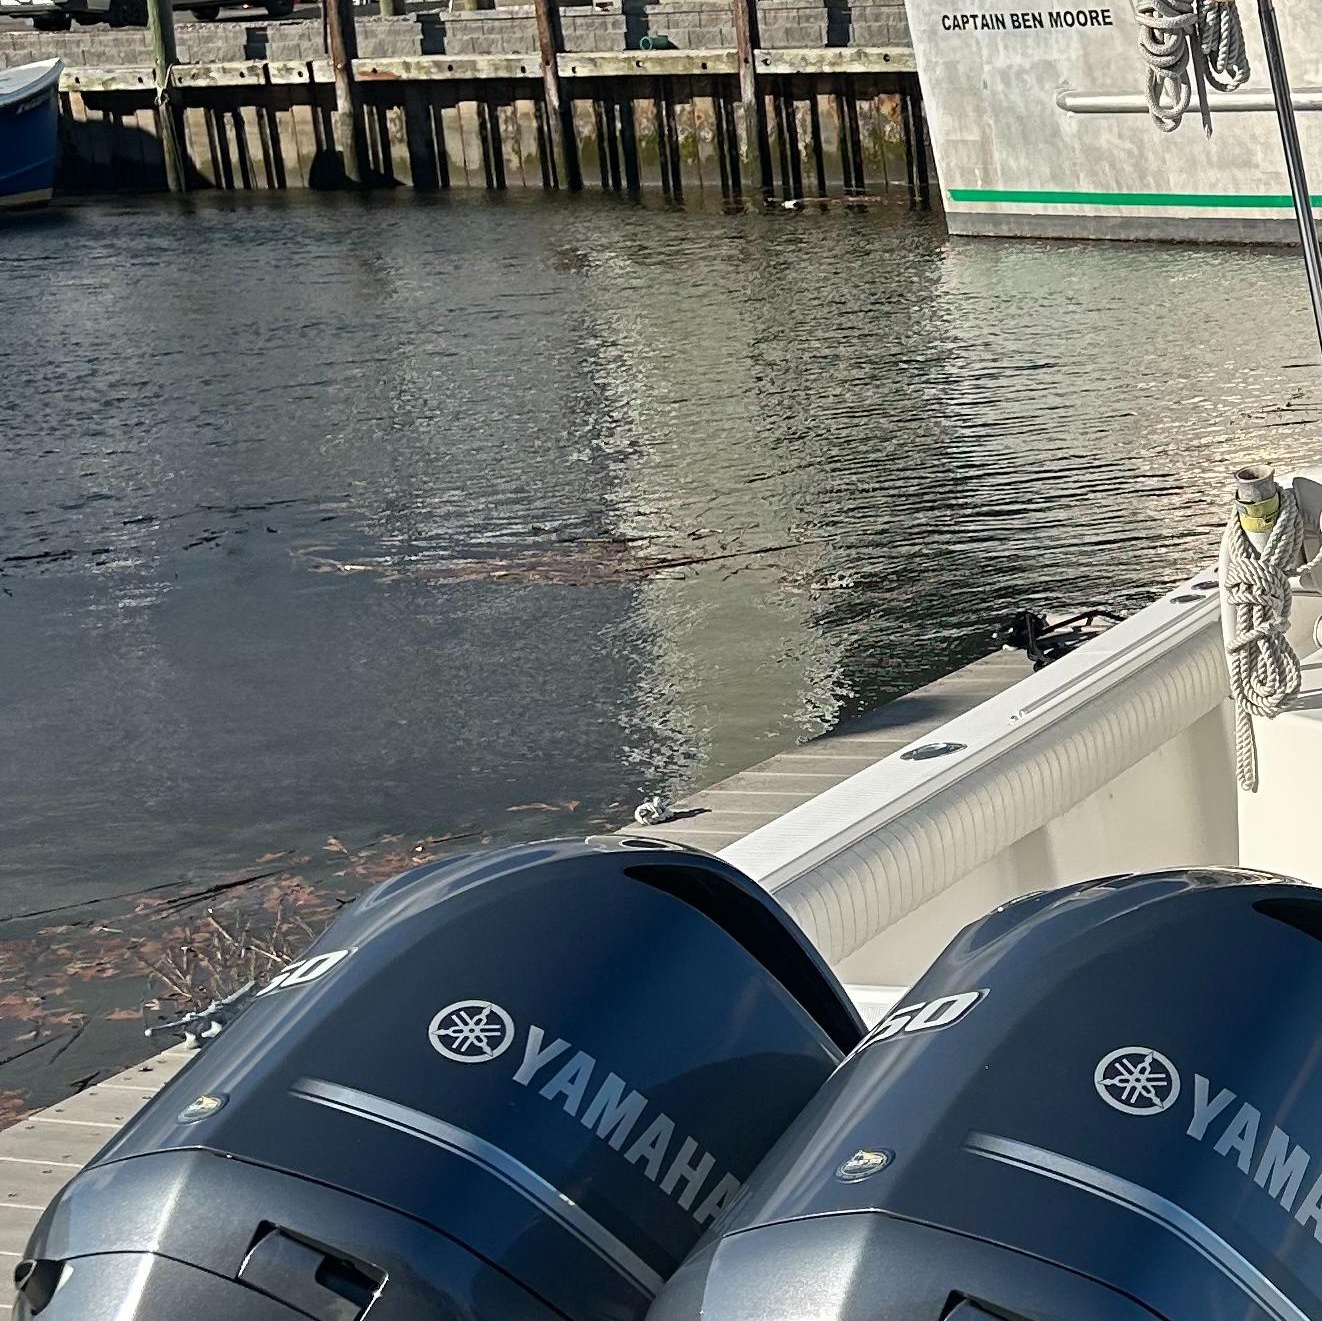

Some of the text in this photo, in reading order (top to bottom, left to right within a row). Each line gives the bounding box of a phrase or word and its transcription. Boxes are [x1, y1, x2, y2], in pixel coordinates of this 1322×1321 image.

[942, 9, 1113, 31] CAPTAIN BEN MOORE
[512, 1025, 743, 1225] YAMAHA
